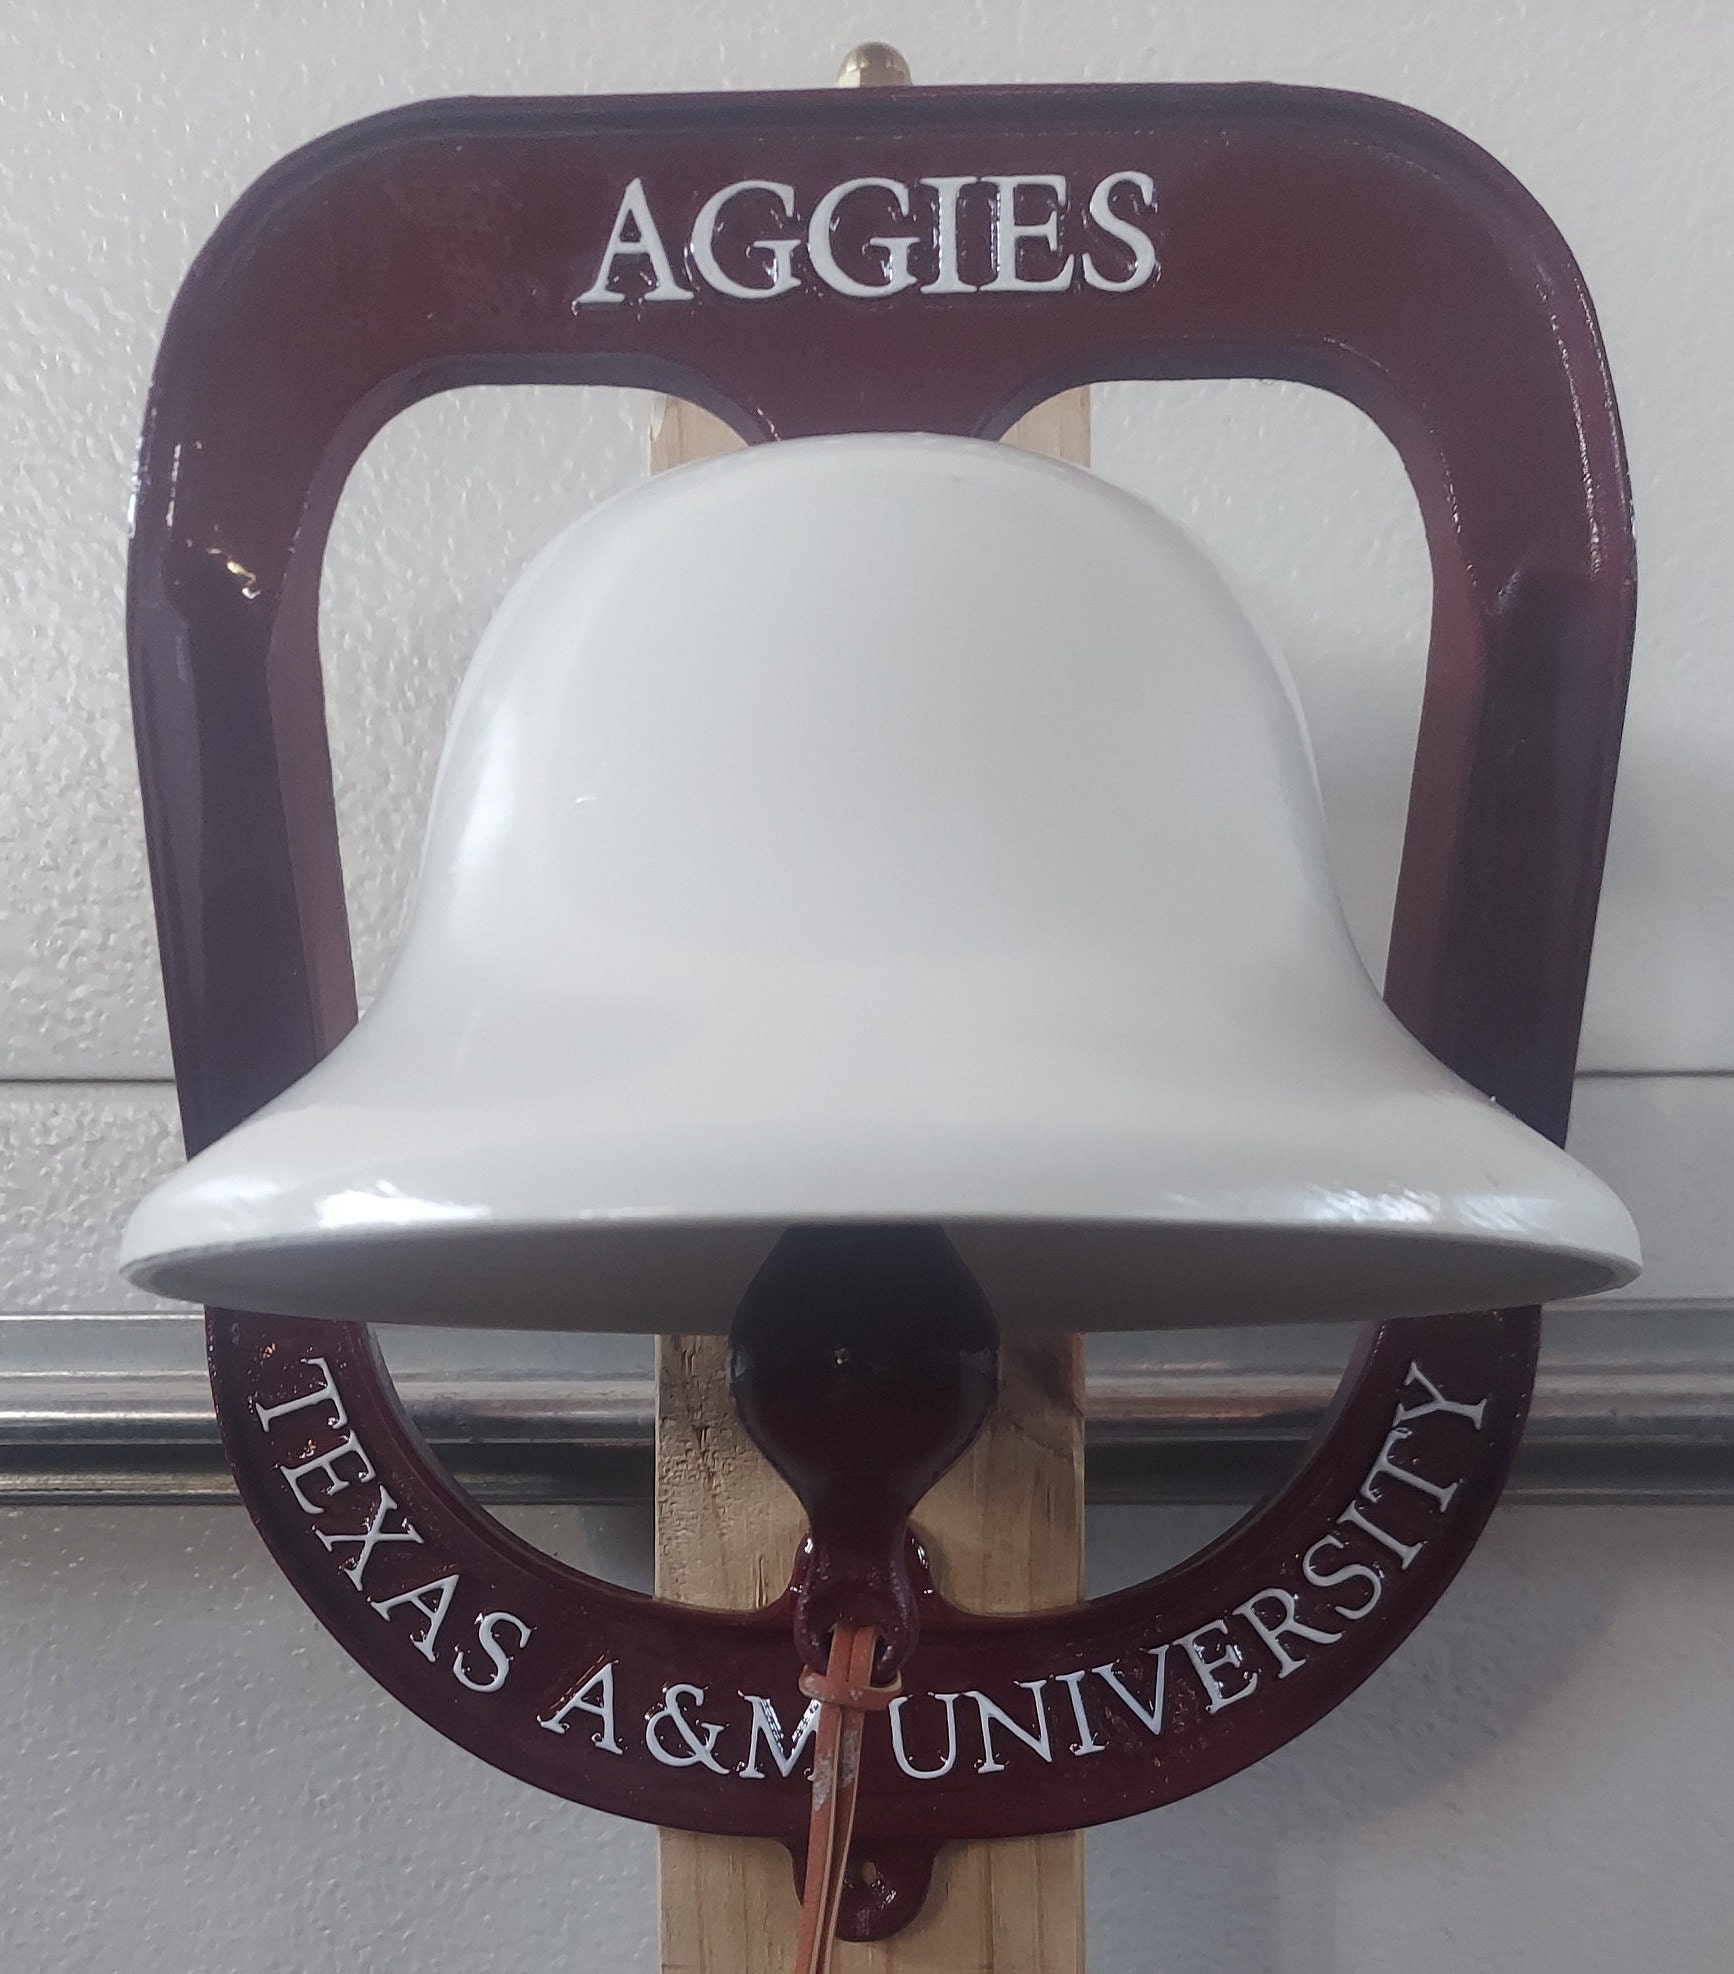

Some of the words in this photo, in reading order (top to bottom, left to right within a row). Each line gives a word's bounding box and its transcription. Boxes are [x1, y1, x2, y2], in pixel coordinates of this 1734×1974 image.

[576, 169, 1158, 303] AGGIES
[254, 1356, 534, 1693] TEXAS
[540, 1662, 821, 1782] A&M
[888, 1362, 1488, 1779] UNIVERSITY
